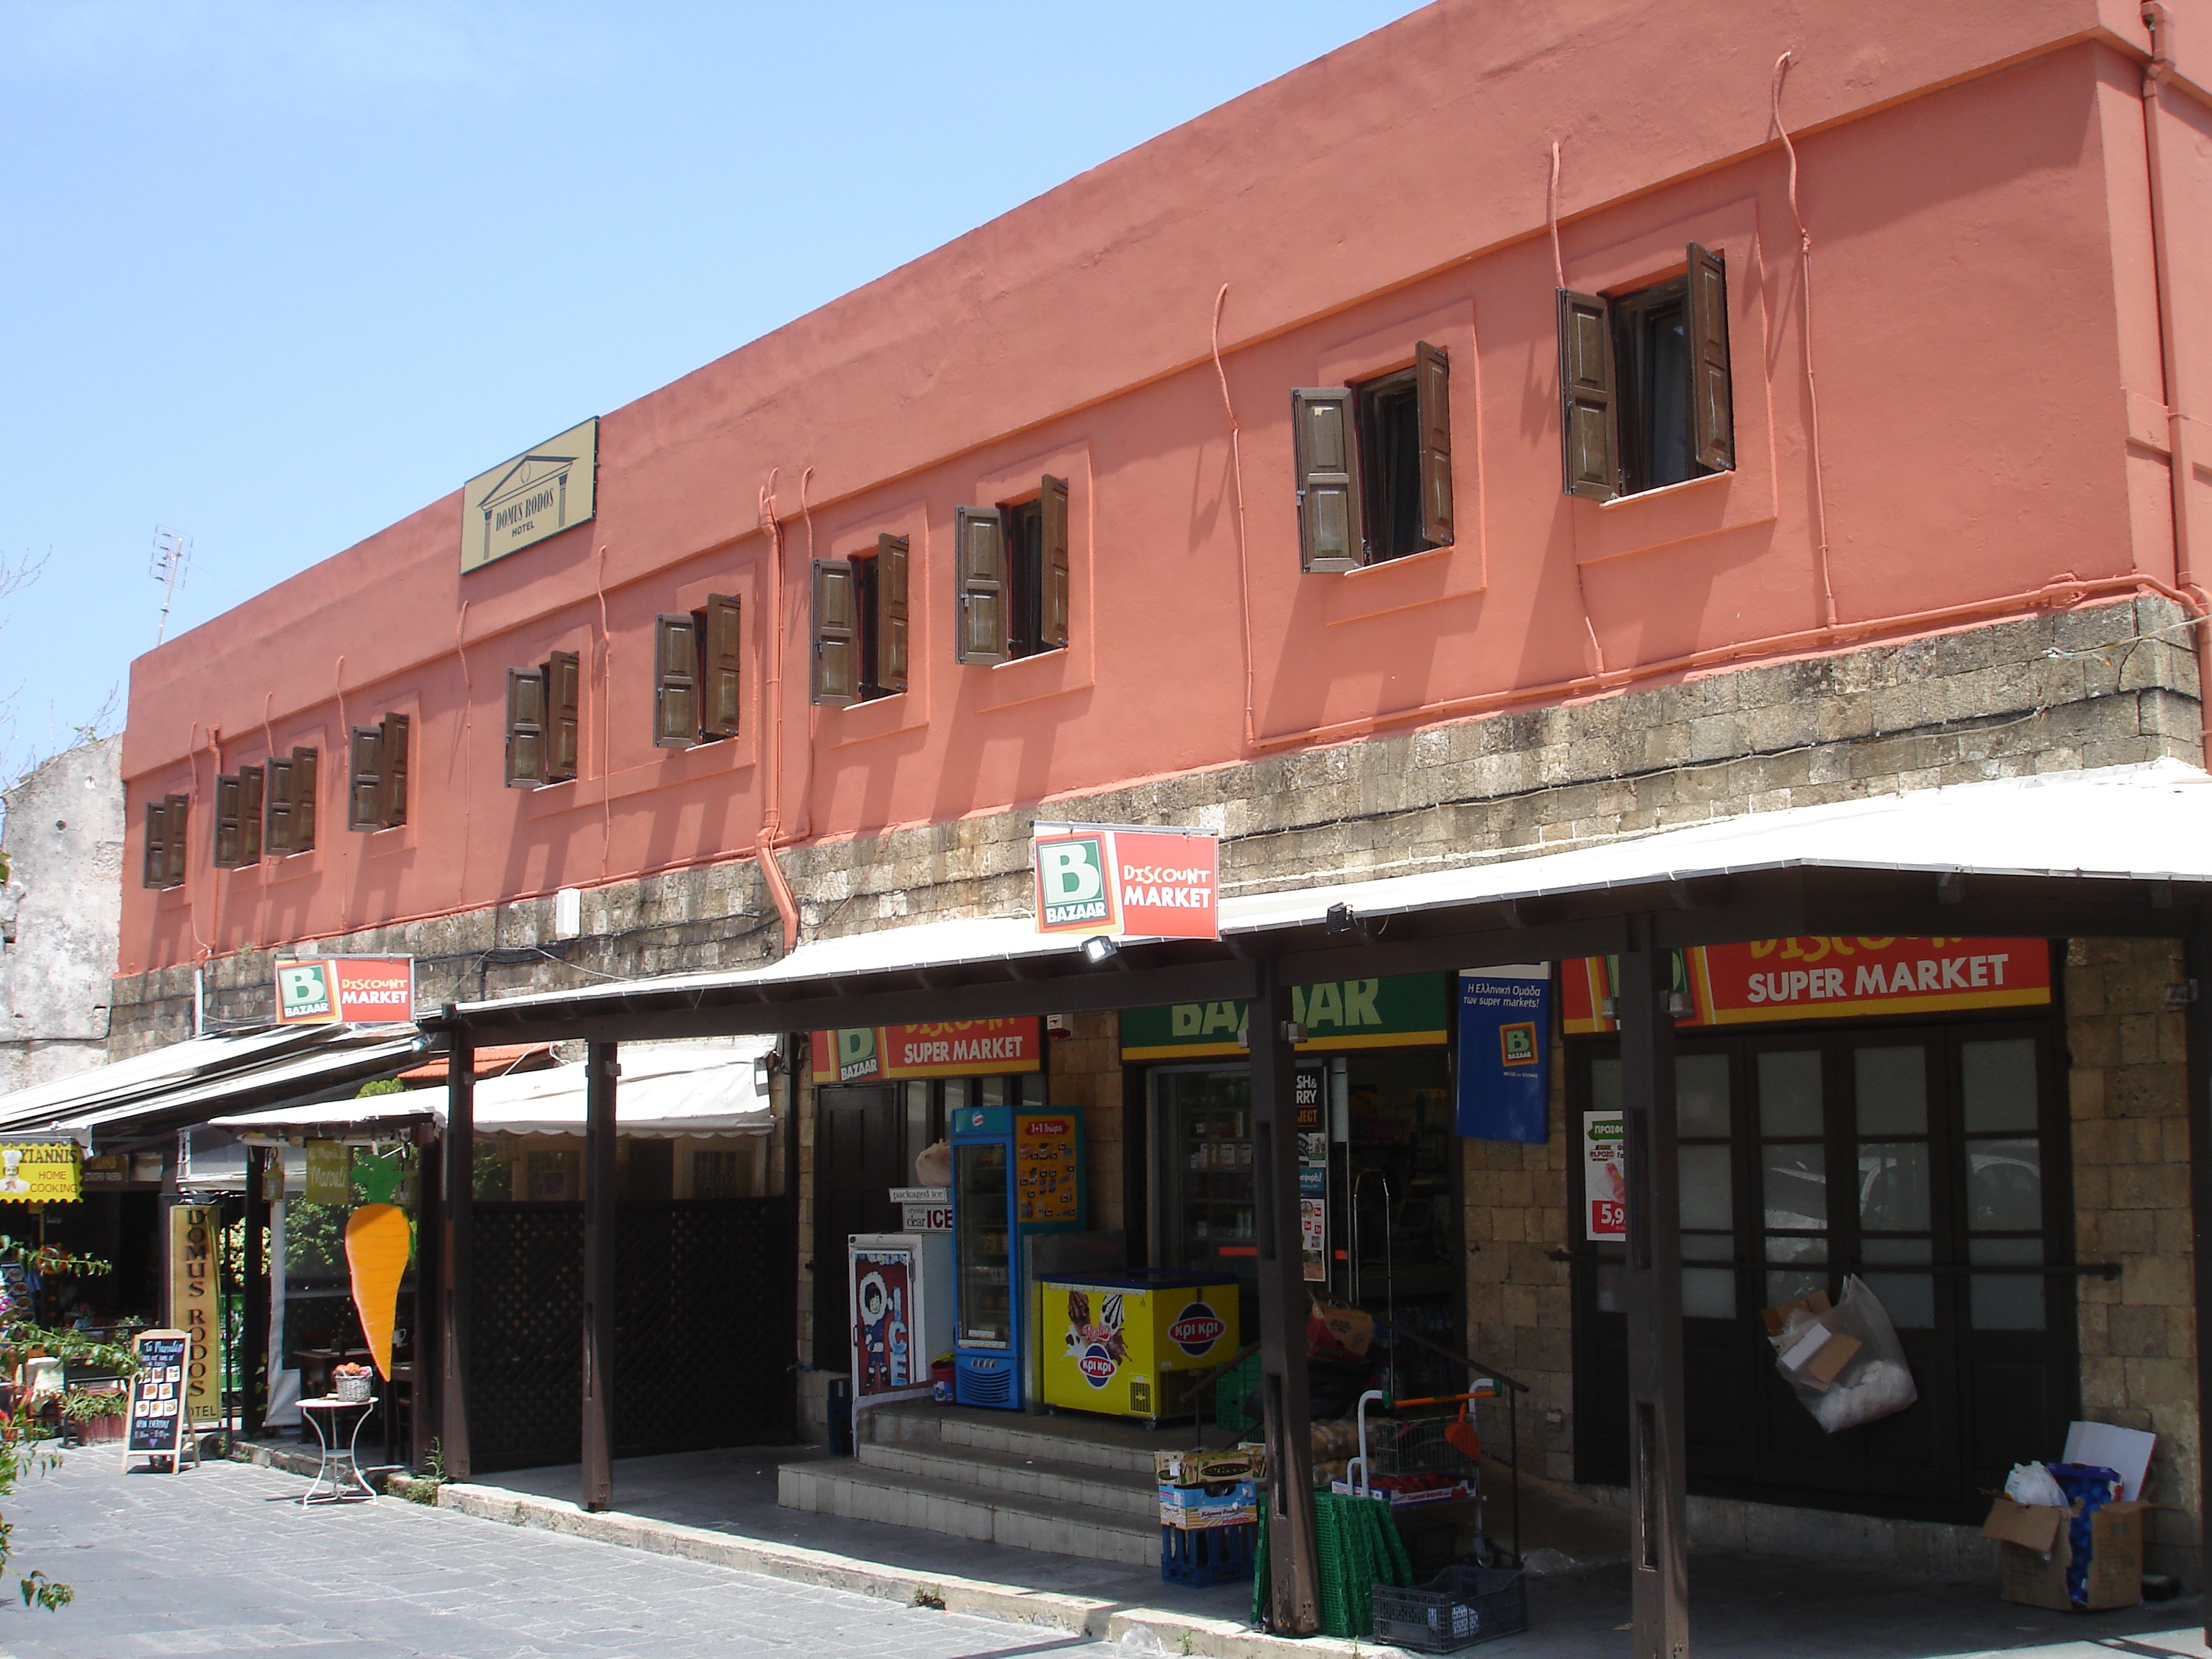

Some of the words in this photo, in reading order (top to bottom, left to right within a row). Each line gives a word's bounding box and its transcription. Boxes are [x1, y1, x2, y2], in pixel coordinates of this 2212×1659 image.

[495, 503, 523, 531] DOMUS
[526, 487, 554, 518] RODOS
[512, 521, 535, 537] HOTEL
[1042, 845, 1100, 901] B
[1123, 865, 1212, 885] DISCOUNT
[1123, 885, 1212, 909] MARKET
[1046, 902, 1107, 924] BAZAAR
[280, 968, 324, 1005] B
[341, 979, 408, 991] DISCOUNT
[1747, 967, 1847, 1004] SUPER
[1854, 953, 2009, 996] MARKET
[341, 991, 408, 1004] MARKET
[1475, 983, 1511, 995] Ελληνική
[1512, 985, 1541, 997] Ομάδα
[284, 1002, 329, 1018] BAZAAR
[1479, 997, 1501, 1007] super
[1503, 997, 1539, 1008] markets!
[1506, 1029, 1531, 1053] B
[904, 1040, 950, 1064] SUPER
[953, 1035, 1023, 1061] MARKET
[1507, 1051, 1532, 1060] BAZAAR
[840, 1059, 878, 1081] BAZAAR
[1296, 1075, 1318, 1089] SH&
[1296, 1089, 1318, 1104] RRY
[1298, 1110, 1318, 1123] JECT
[1594, 1125, 1624, 1134] ΠΡΟΣΦ
[19, 1148, 78, 1164] YIANNIS
[38, 1171, 67, 1180] HOME
[30, 1183, 78, 1193] COOKING
[893, 1190, 930, 1200] packaged
[907, 1215, 925, 1227] clear
[927, 1208, 953, 1228] ICE
[1601, 1202, 1625, 1226] 5,9
[186, 1210, 205, 1298] DOMUS
[888, 1286, 908, 1387] ICE
[187, 1309, 207, 1397] RODOS
[191, 1406, 216, 1417] TEL
